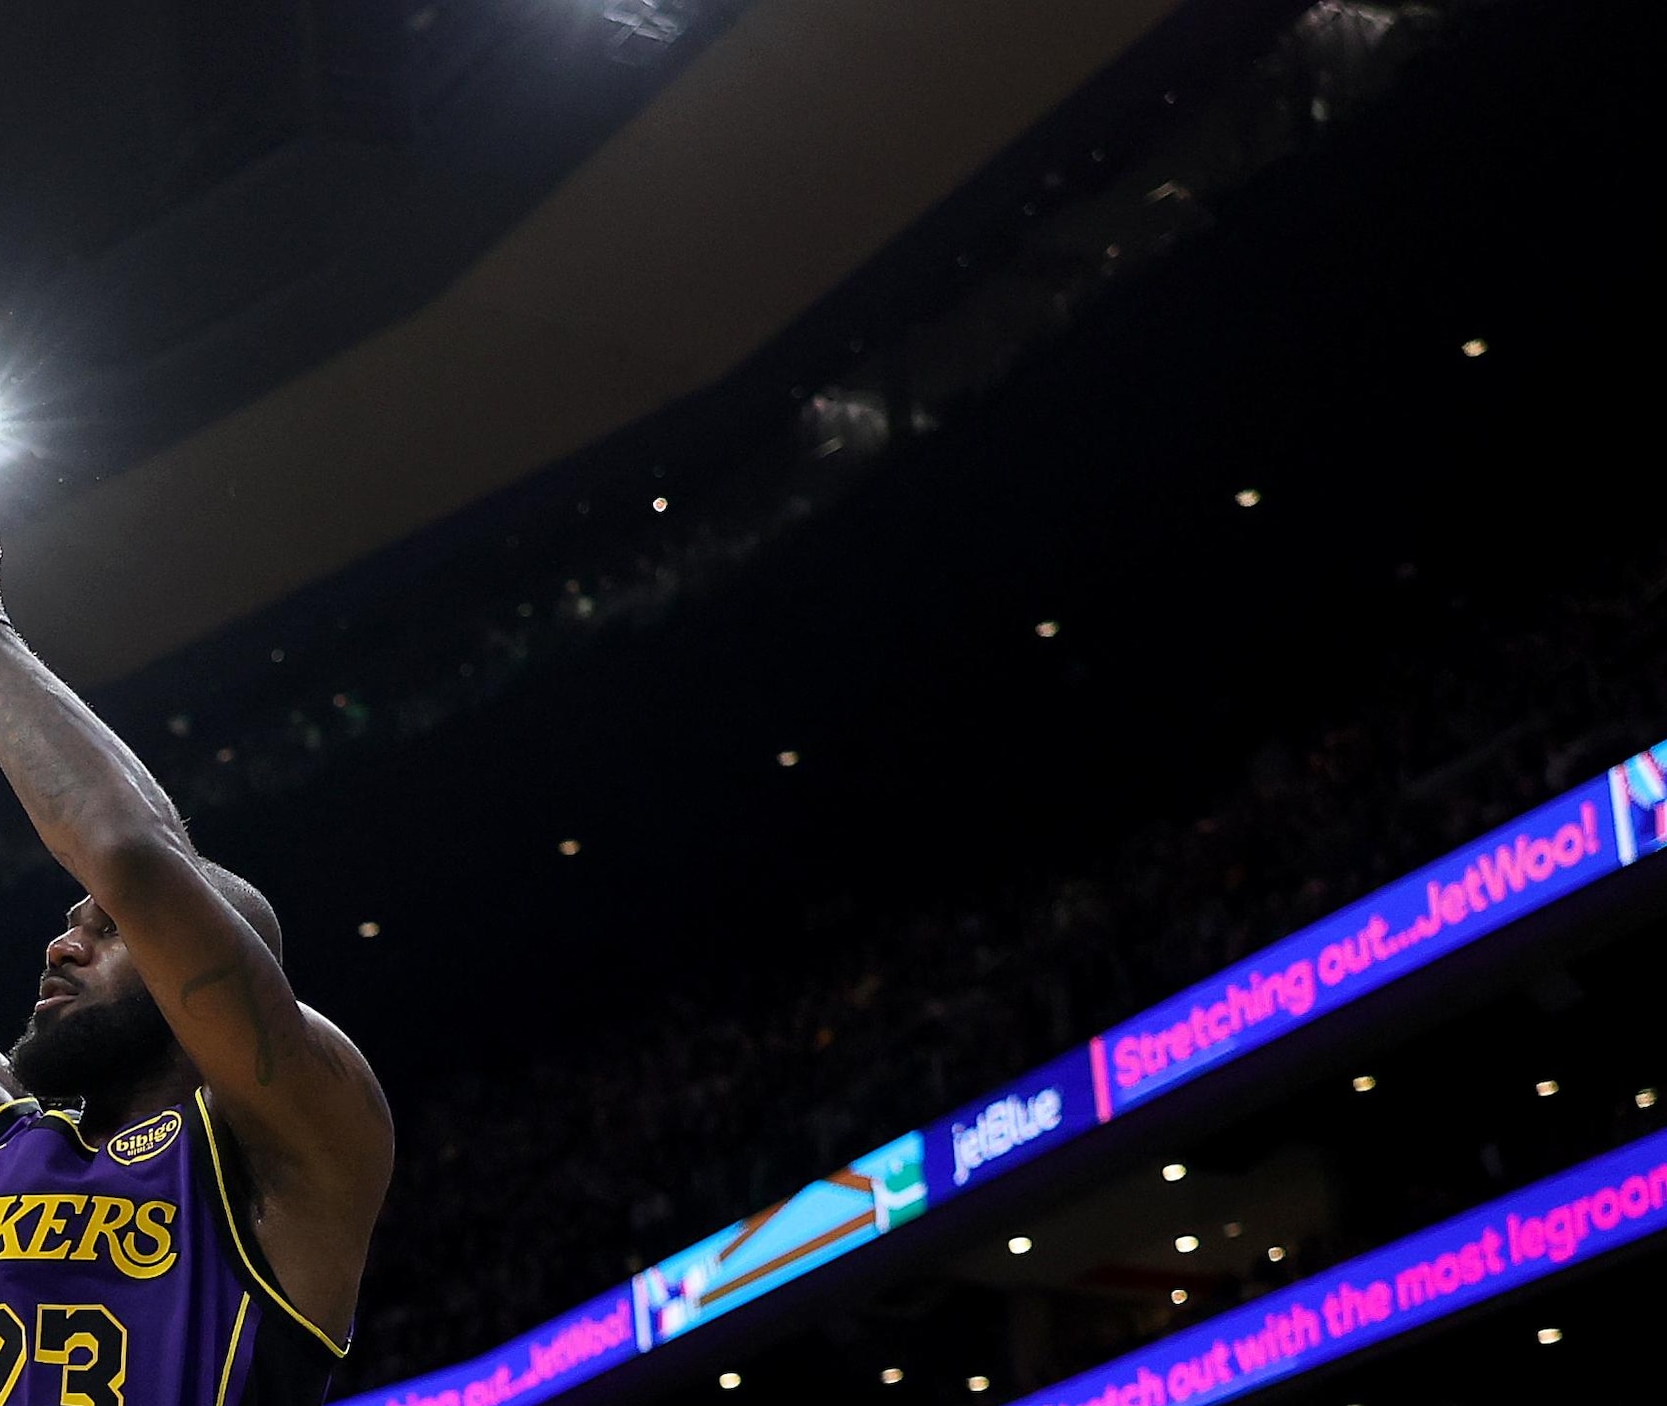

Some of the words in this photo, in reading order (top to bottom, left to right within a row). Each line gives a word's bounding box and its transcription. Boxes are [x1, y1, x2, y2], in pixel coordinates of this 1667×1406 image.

[1114, 959, 1314, 1088] Stretching
[116, 1119, 177, 1152] bibigo
[952, 1087, 1063, 1186] jetBlue
[1168, 1341, 1233, 1402] out
[1234, 1302, 1322, 1374] with
[1322, 1281, 1392, 1338] the
[1396, 1228, 1505, 1310] most
